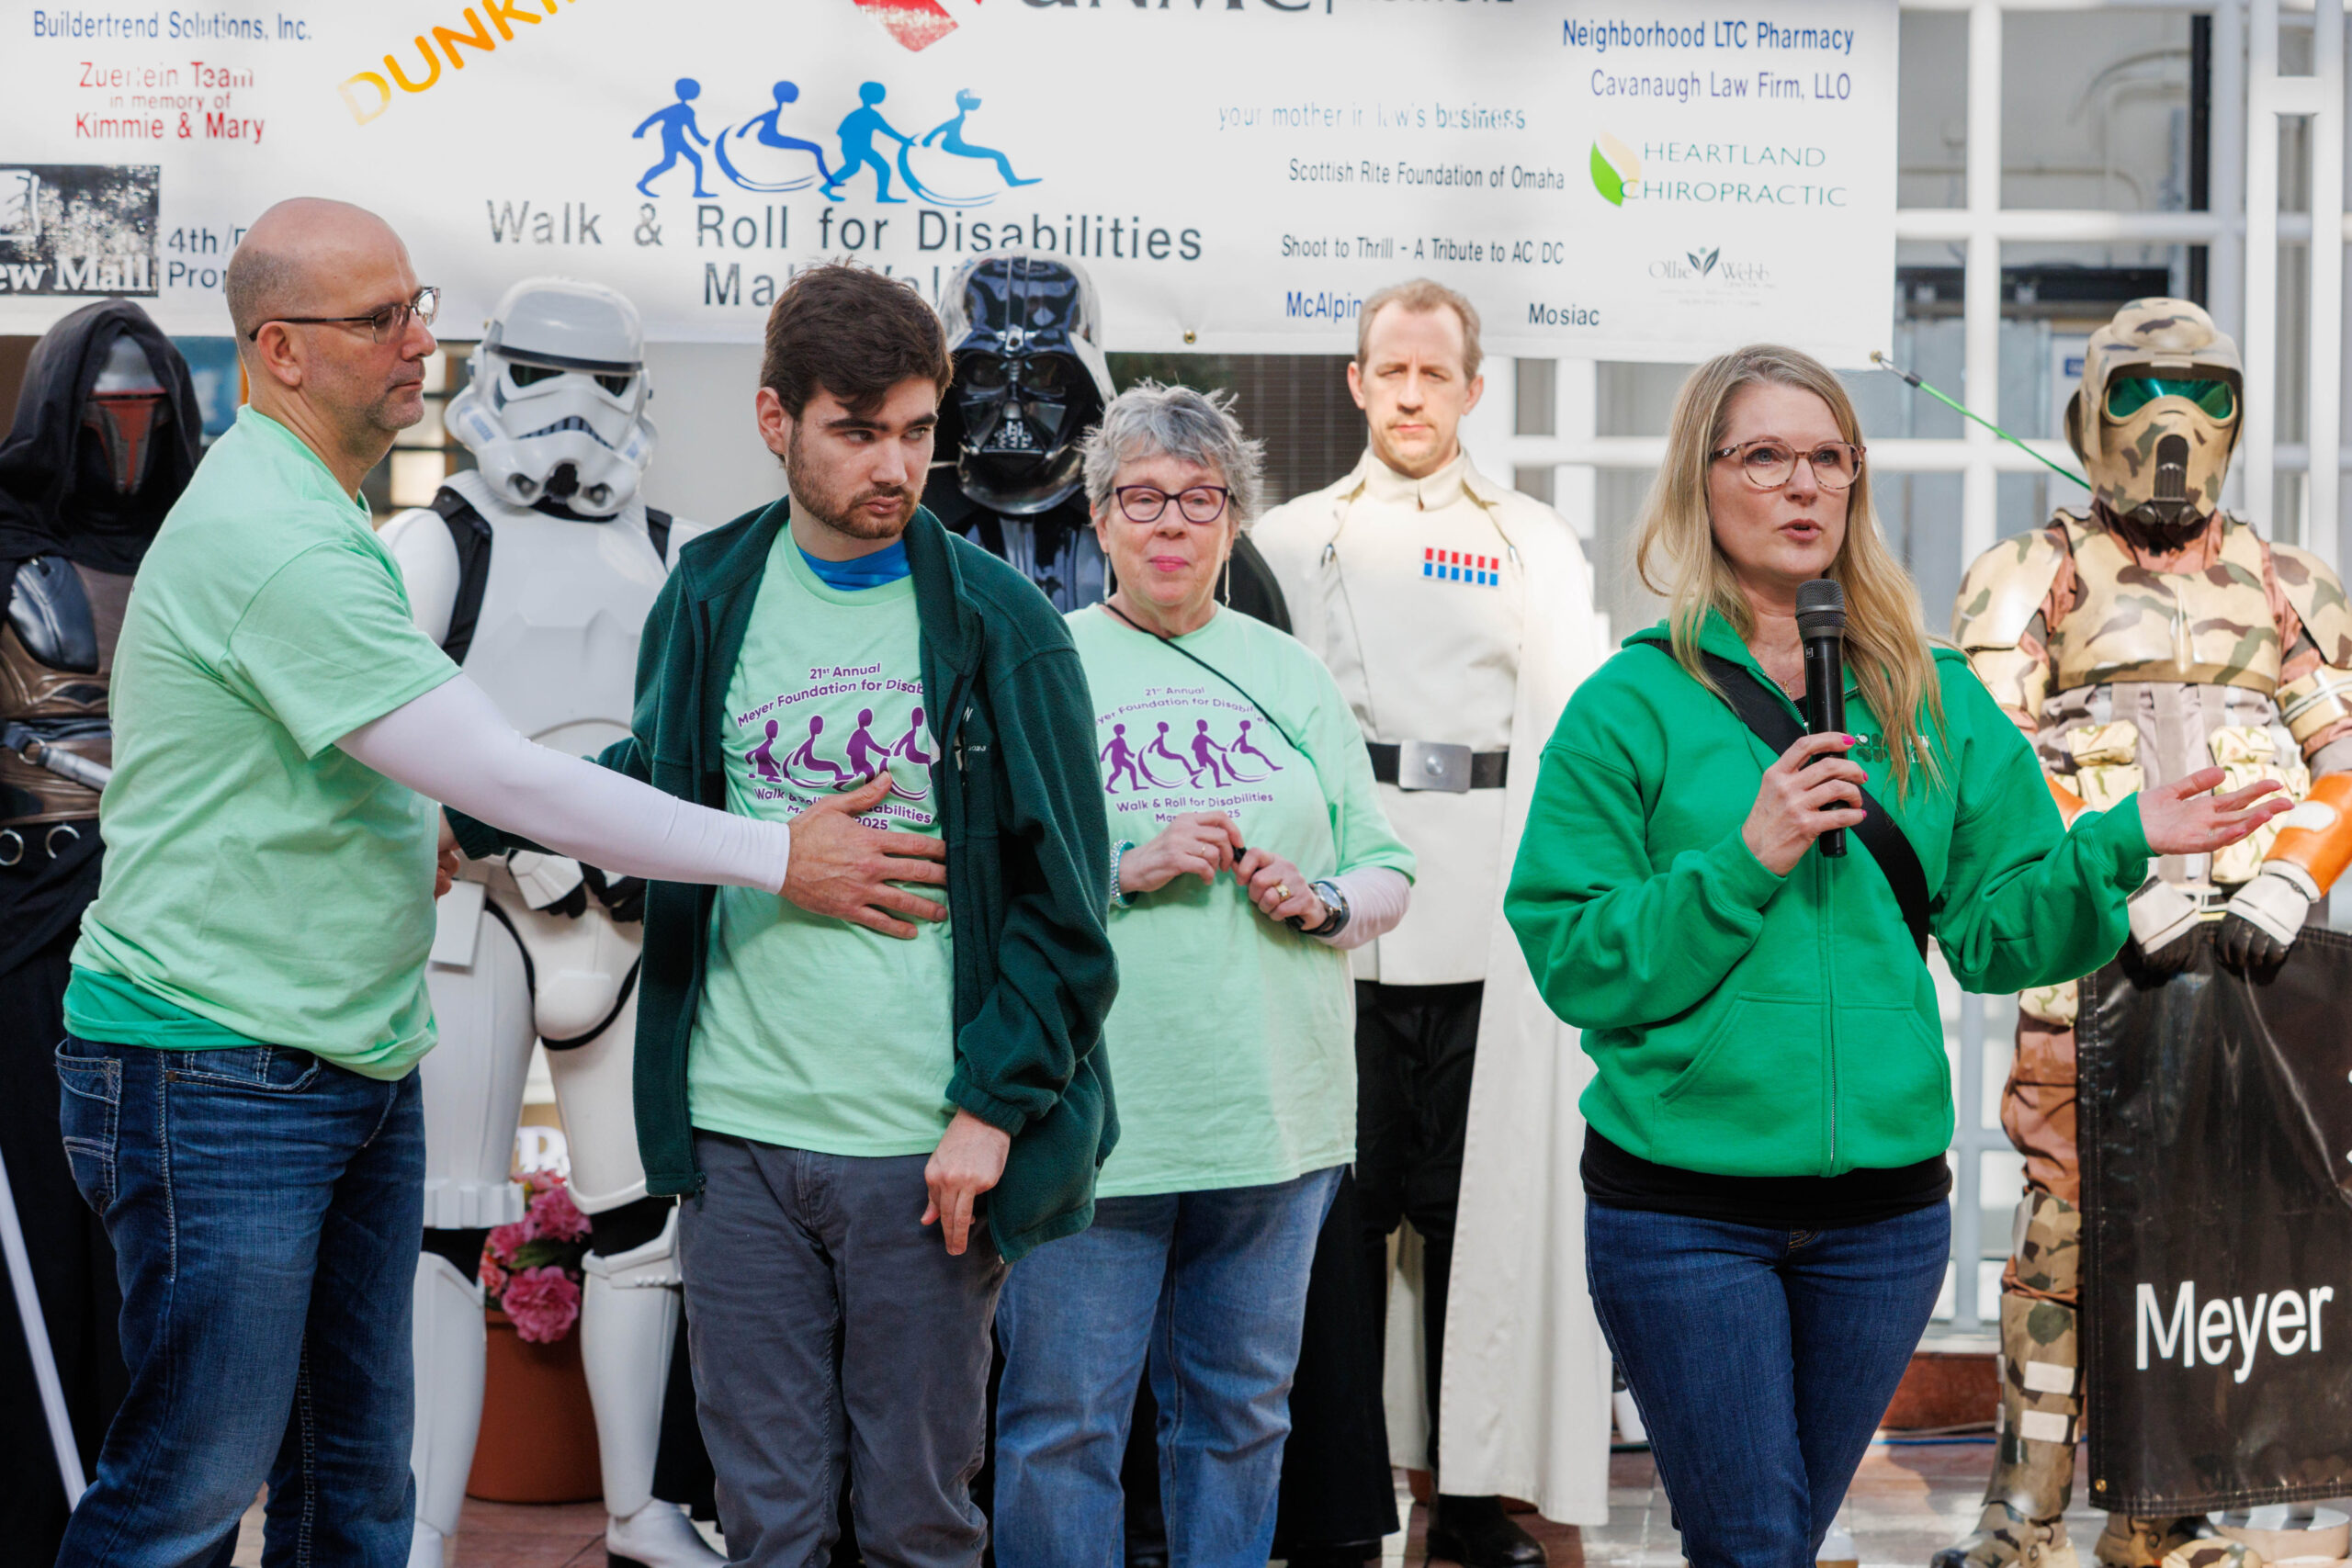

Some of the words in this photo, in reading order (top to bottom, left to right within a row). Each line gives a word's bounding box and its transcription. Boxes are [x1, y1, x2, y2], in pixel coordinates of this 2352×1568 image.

[33, 10, 159, 38] Buildertrend
[277, 13, 312, 40] Inc.
[1563, 18, 1705, 52] Neighborhood
[1714, 20, 1747, 48] LTC
[1758, 21, 1854, 55] Pharmacy
[190, 61, 254, 87] Team
[337, 0, 577, 126] DUNK
[1591, 69, 1701, 103] Cavanaugh
[1711, 71, 1748, 97] Law
[1758, 72, 1805, 100] Firm,
[132, 95, 205, 112] memory
[214, 92, 232, 108] of
[75, 112, 164, 139] Kimmie
[177, 112, 193, 139] &
[206, 111, 265, 144] Mary
[1644, 141, 1826, 167] HEARTLAND
[1288, 157, 1354, 183] Scottish
[1361, 160, 1390, 184] Rite
[1396, 161, 1483, 186] Foundation
[1489, 164, 1505, 188] of
[1511, 164, 1565, 190] Omaha
[1620, 179, 1847, 208] CHIROPRACTIC
[486, 199, 603, 245] Walk
[633, 202, 664, 247] &
[695, 203, 789, 249] Roll
[818, 207, 889, 251] for
[919, 209, 1203, 261] Disabilities
[1282, 234, 1328, 258] Shoot
[1335, 237, 1350, 258] to
[1356, 236, 1394, 259] Thrill
[1414, 237, 1424, 260] A
[1431, 237, 1484, 262] Tribute
[1490, 240, 1506, 263] to
[53, 254, 152, 291] Mall
[1527, 302, 1600, 326] Mosiac
[832, 662, 881, 678] Annual
[737, 701, 775, 728] Meyer
[777, 682, 857, 708] Foundation
[861, 679, 882, 691] for
[1165, 686, 1205, 695] Annual
[1118, 697, 1189, 715] Foundation
[1193, 697, 1209, 705] for
[753, 787, 785, 800] Walk
[1116, 799, 1148, 812] Walk
[1152, 798, 1161, 808] &
[1165, 796, 1186, 807] Roll
[1190, 797, 1205, 807] for
[1208, 792, 1273, 807] Disabilities
[2135, 1280, 2335, 1384] Meyer
